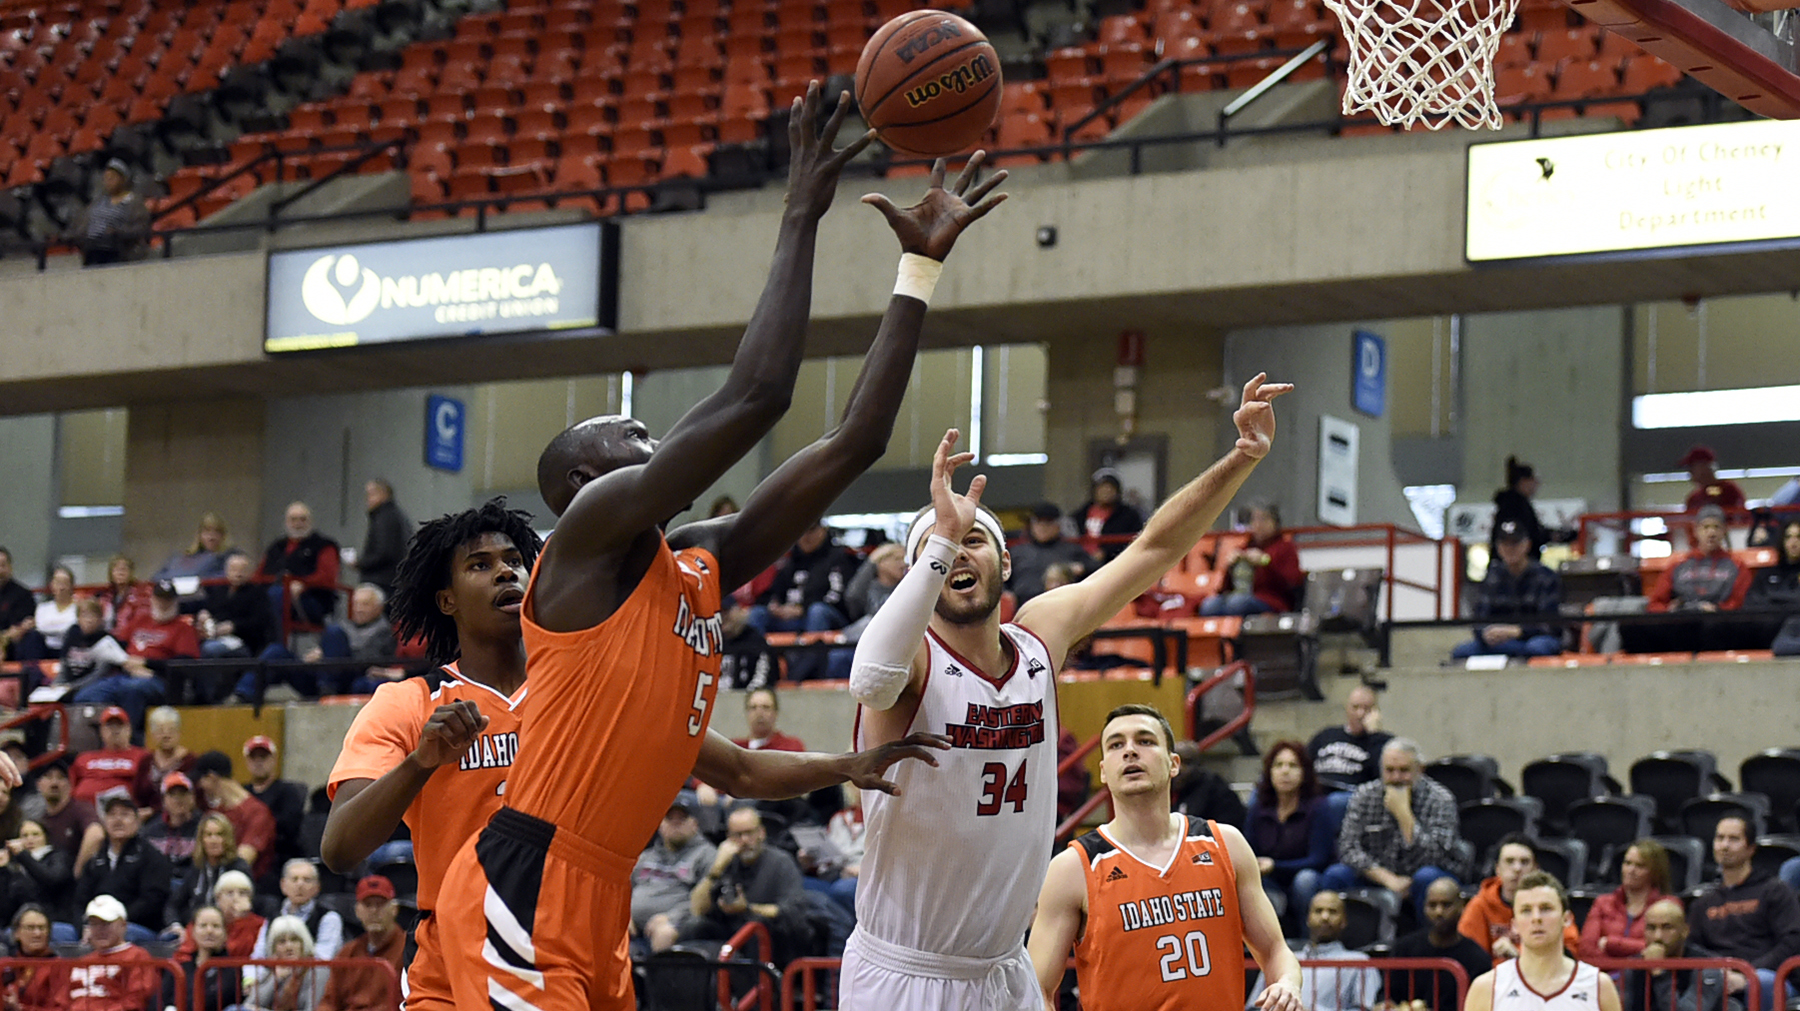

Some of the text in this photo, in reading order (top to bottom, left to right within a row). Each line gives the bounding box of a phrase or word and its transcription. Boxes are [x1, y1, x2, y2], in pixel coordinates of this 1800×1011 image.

[896, 22, 961, 64] NCAA
[904, 53, 994, 108] Wilson
[1604, 139, 1785, 172] City Of Cheney
[1663, 175, 1724, 200] Light
[1619, 202, 1768, 234] Department
[380, 262, 558, 309] NUMERICA
[434, 297, 559, 324] CREDIT UNION
[1361, 337, 1380, 379] D
[435, 401, 458, 439] C
[688, 671, 714, 737] 5
[965, 699, 1043, 728] EASTERN
[976, 758, 1028, 817] 34
[1119, 888, 1225, 932] IDAHO STATE
[1156, 930, 1211, 982] 20
